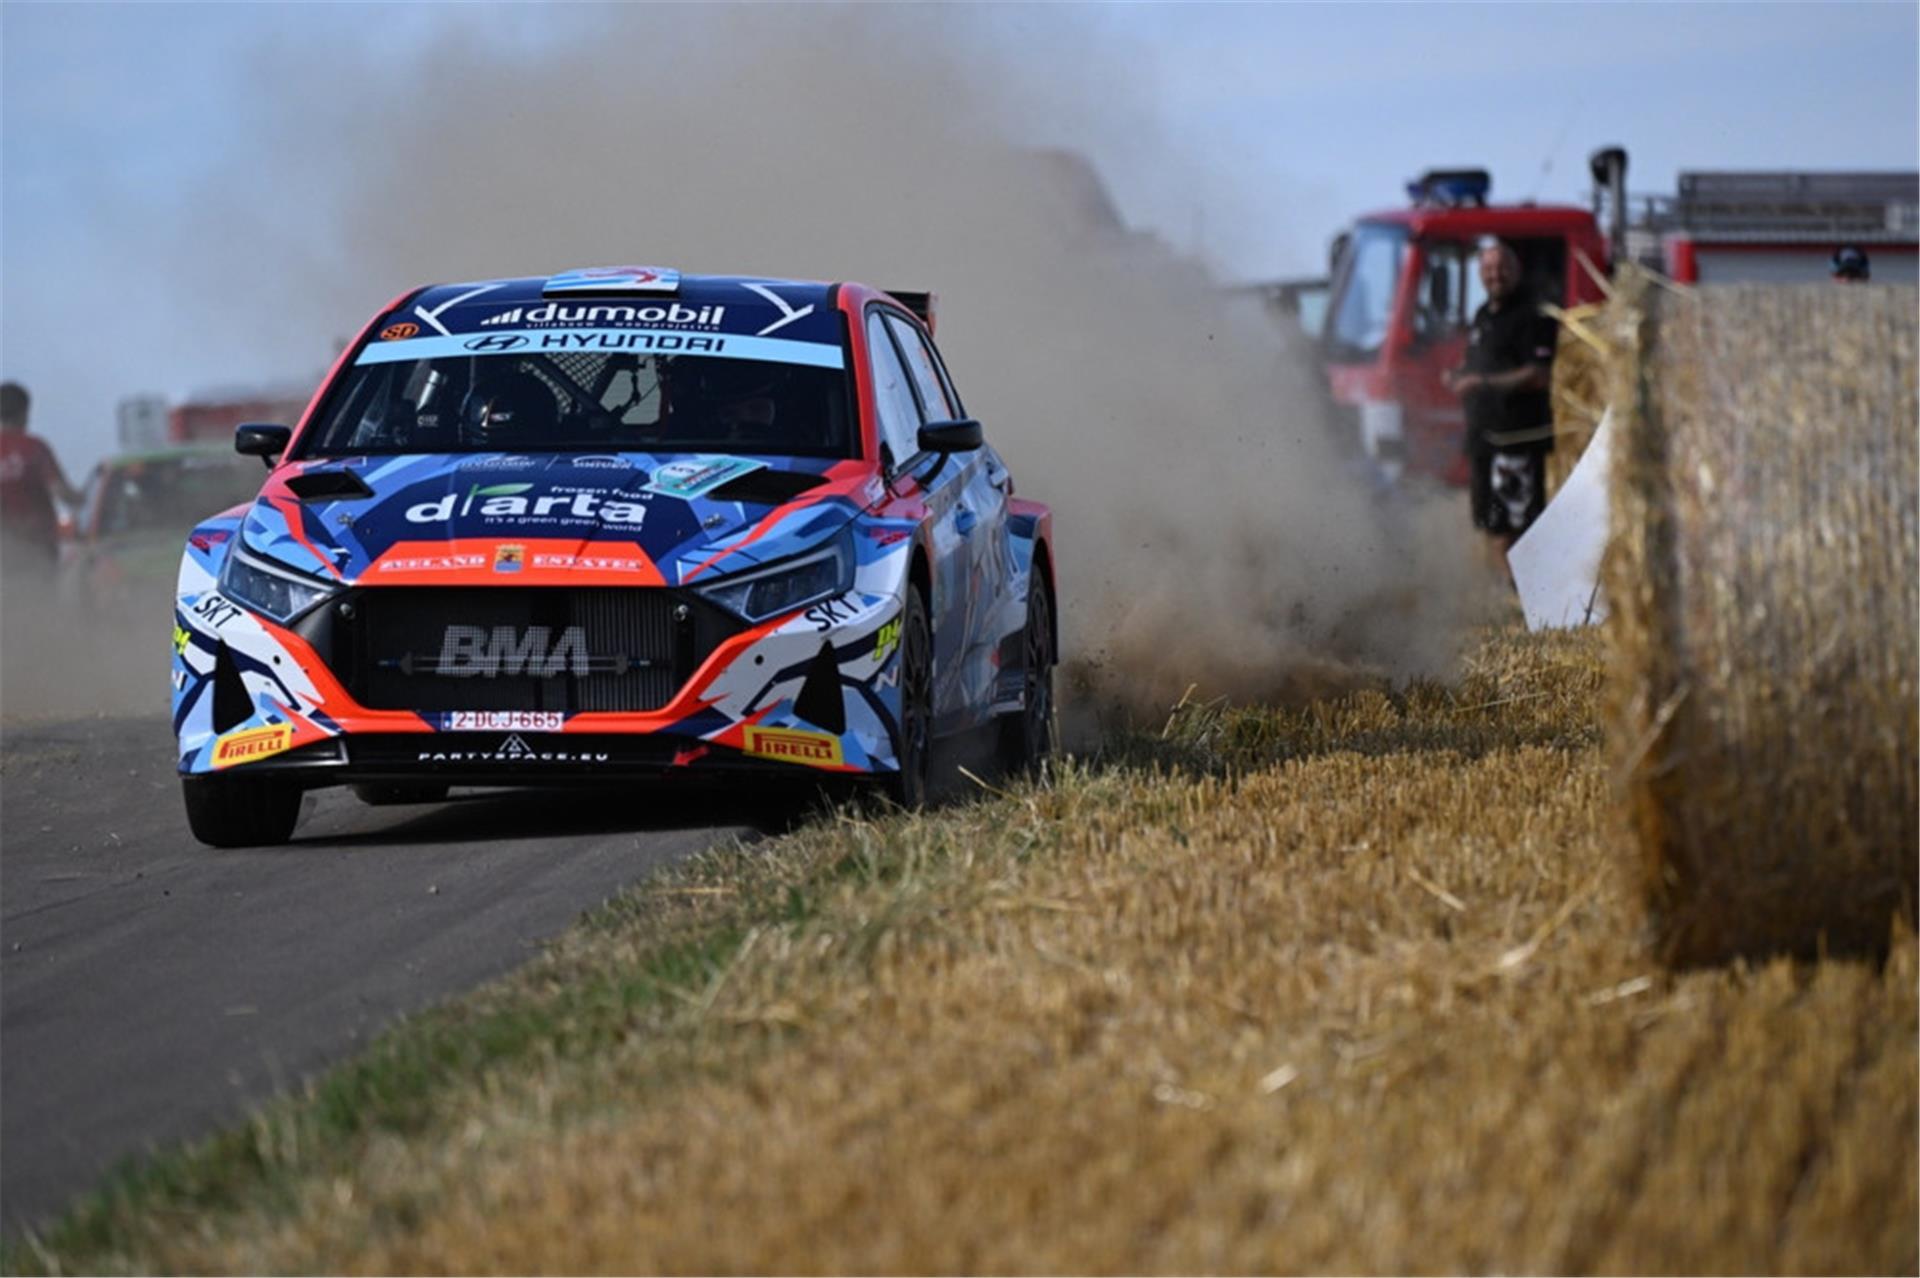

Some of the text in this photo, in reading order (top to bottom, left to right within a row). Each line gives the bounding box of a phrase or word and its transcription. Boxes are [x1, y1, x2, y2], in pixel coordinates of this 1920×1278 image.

[526, 303, 725, 325] dumobil
[541, 333, 725, 352] HYUNDAI
[551, 485, 654, 500] frozen food
[518, 516, 557, 526] green
[602, 523, 643, 532] world
[193, 595, 242, 628] SKT
[805, 594, 860, 632] SKT
[435, 625, 589, 678] BMA
[455, 712, 560, 728] 2-DCJ-665
[218, 730, 285, 759] PIRELLI
[752, 732, 833, 759] PIRELLI
[418, 753, 608, 761] PARTYSPACE.EU
